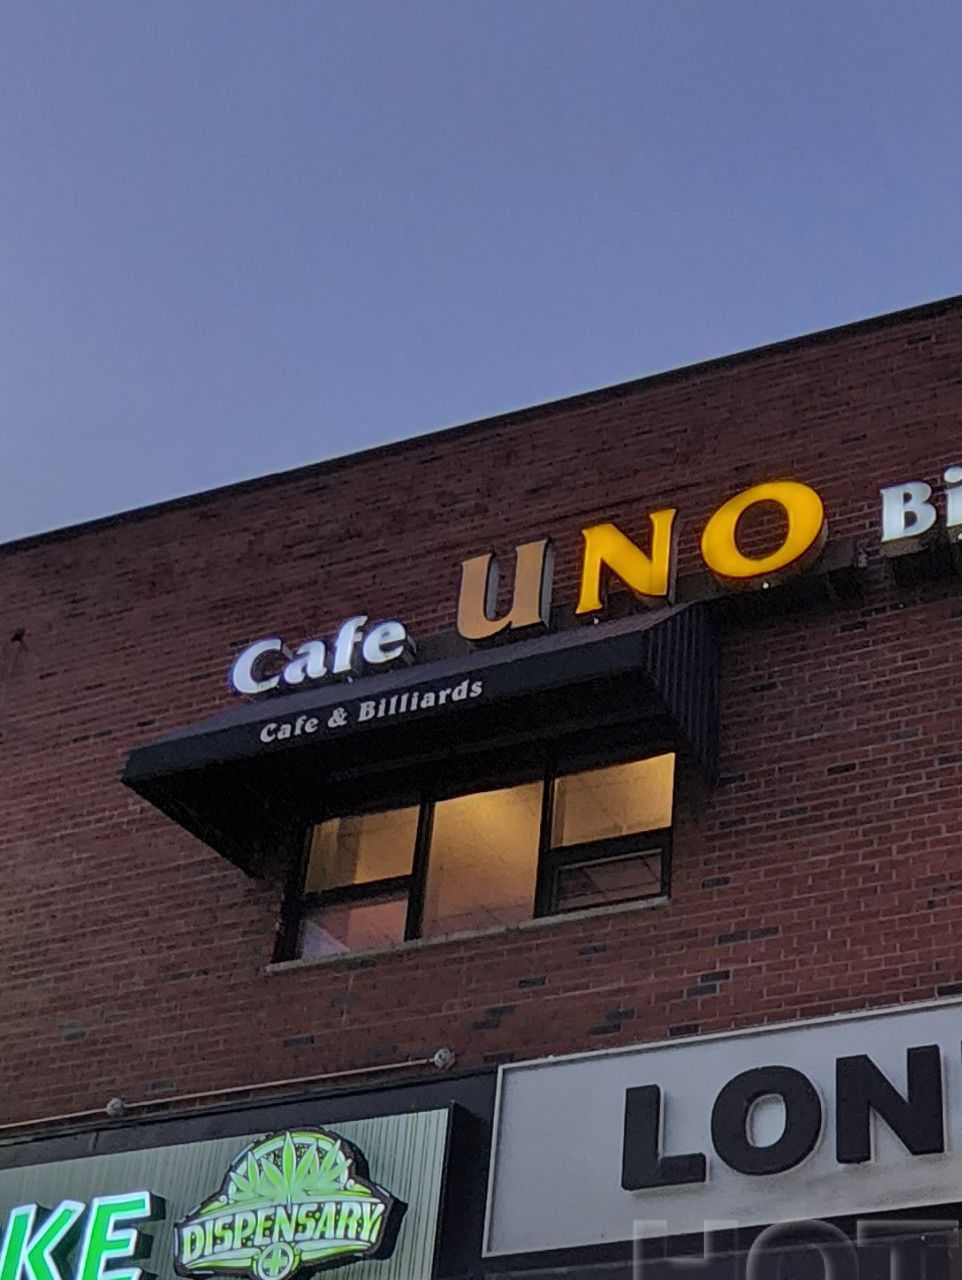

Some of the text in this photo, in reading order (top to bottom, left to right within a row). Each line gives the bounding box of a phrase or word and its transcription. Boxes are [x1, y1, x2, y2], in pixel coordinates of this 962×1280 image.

[231, 615, 407, 695] Cafe
[259, 679, 484, 744] Cafe & Billiards
[182, 1202, 386, 1265] DISPENSARY
